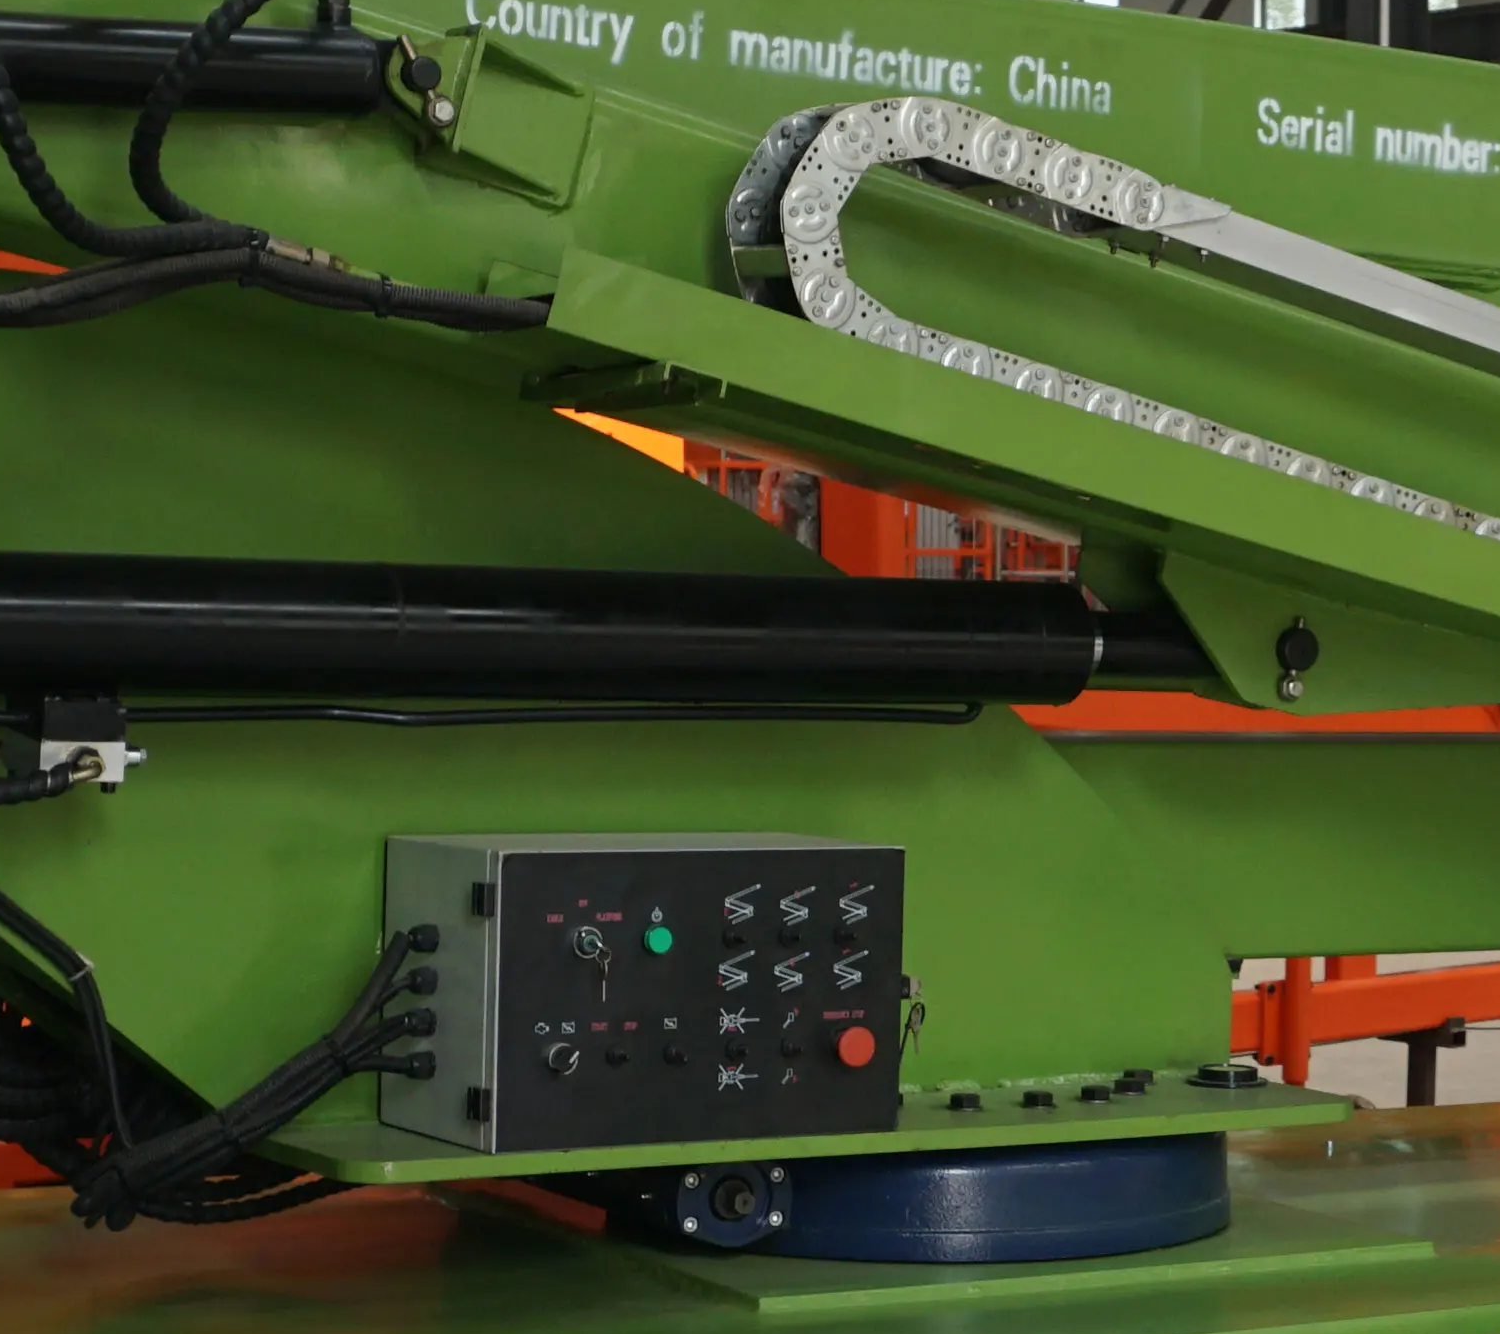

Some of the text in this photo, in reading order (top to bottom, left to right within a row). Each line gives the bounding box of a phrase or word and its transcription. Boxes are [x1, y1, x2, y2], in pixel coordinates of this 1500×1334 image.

[660, 11, 705, 60] of
[728, 29, 984, 97] manufacture:
[1008, 55, 1112, 114] China
[1257, 97, 1355, 157] Serial
